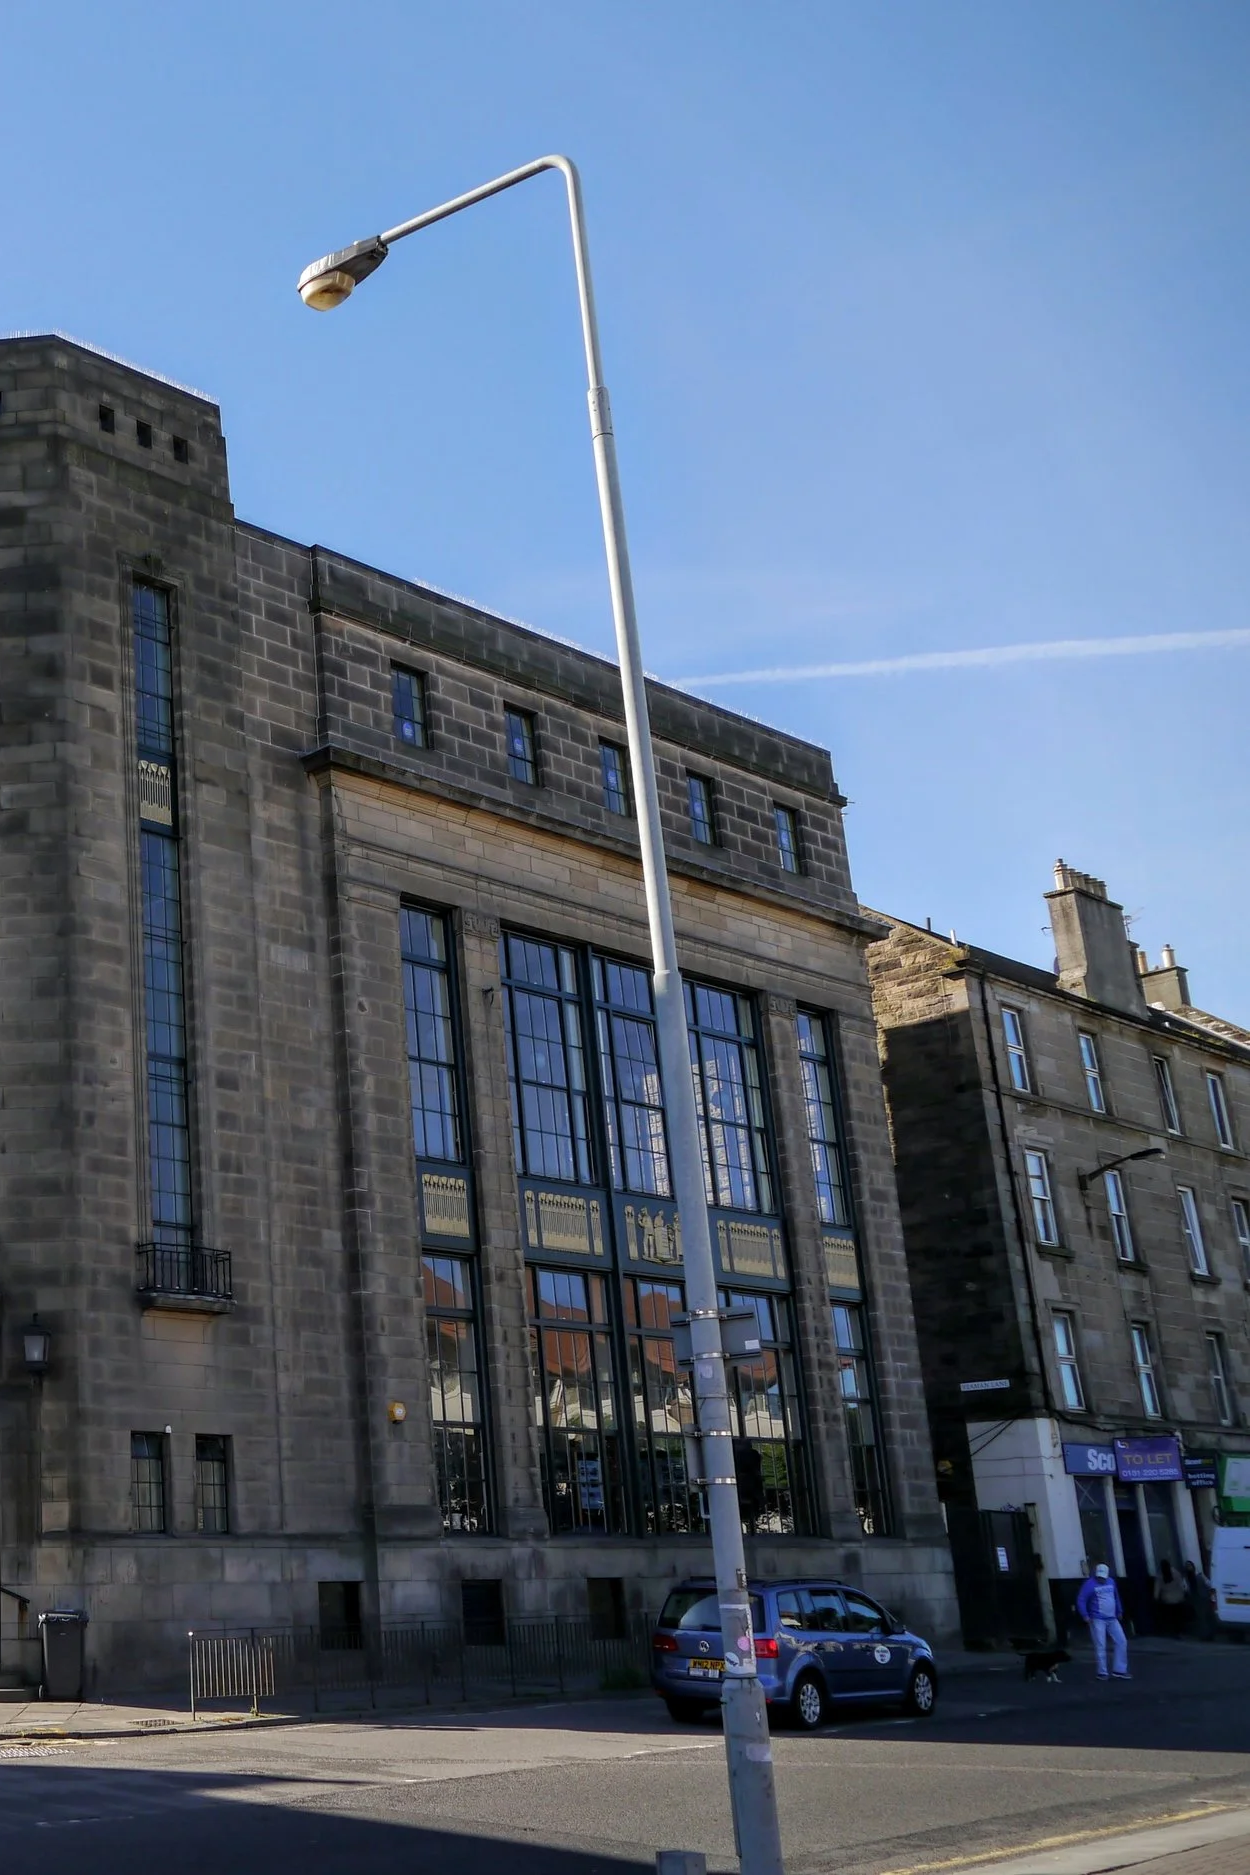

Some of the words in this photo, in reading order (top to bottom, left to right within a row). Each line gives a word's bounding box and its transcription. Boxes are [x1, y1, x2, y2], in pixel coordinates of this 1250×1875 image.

[1123, 1454, 1144, 1465] TO
[1147, 1453, 1173, 1464] LET
[1188, 1472, 1215, 1480] betting
